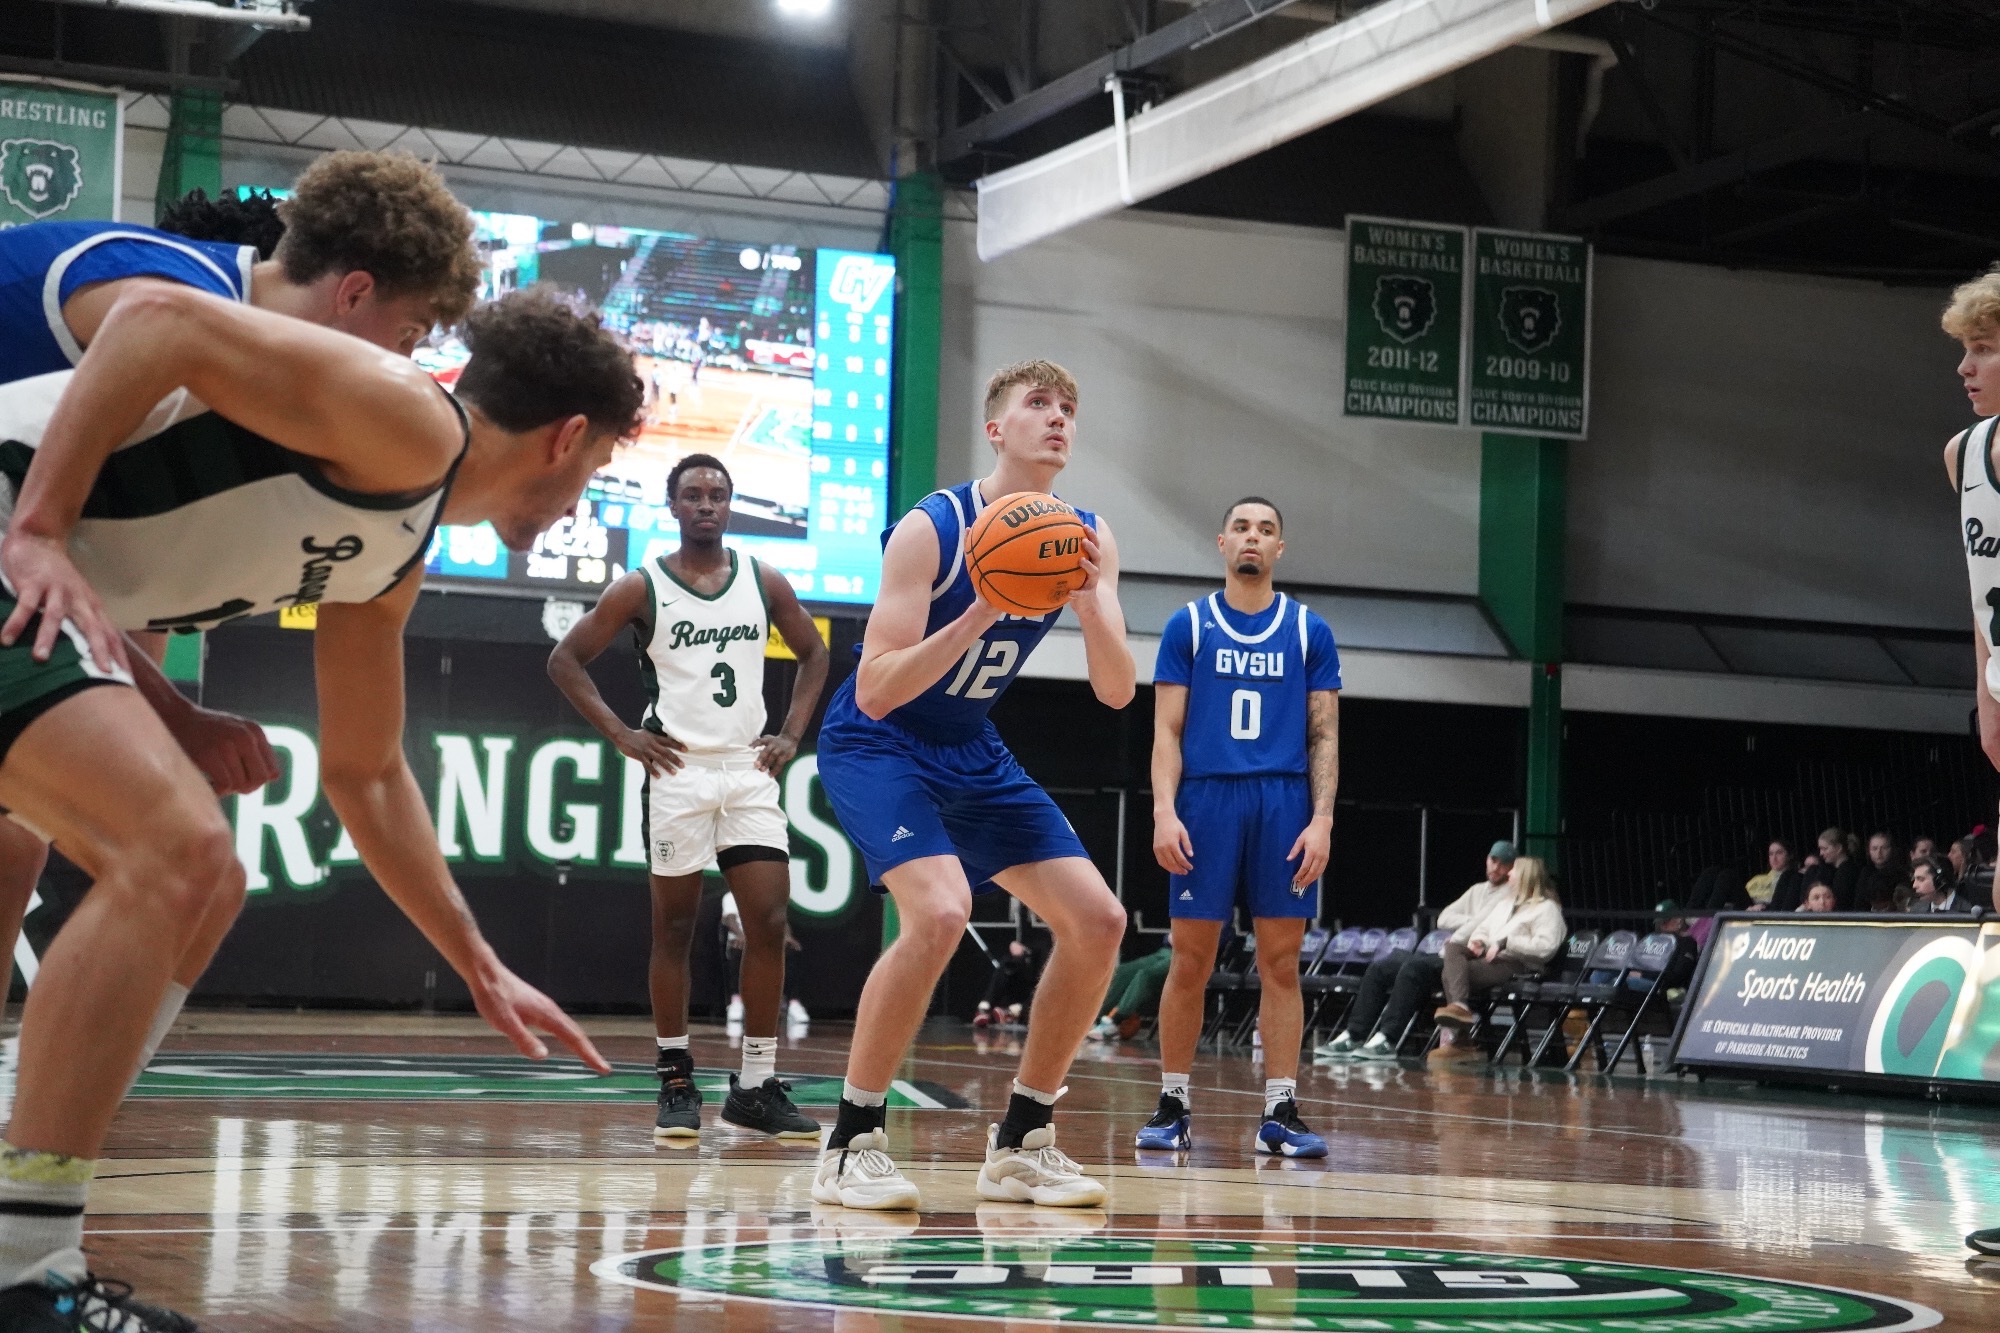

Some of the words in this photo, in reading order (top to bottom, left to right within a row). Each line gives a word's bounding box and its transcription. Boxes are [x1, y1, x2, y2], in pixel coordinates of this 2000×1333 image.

[1368, 226, 1446, 251] WOMEN'S
[1494, 238, 1570, 262] WOMEN'S
[1354, 244, 1459, 273] BASKETBALL
[1480, 256, 1582, 283] BASKETBALL
[1368, 346, 1439, 373] 2011-12
[1486, 356, 1570, 383] 2009-10
[1407, 383, 1453, 398] DIVISION
[1347, 392, 1457, 420] CHAMPIONS
[1473, 401, 1581, 429] CHAMPIONS
[1038, 537, 1079, 560] EVO
[668, 620, 760, 653] Rangers
[945, 638, 1020, 700] 12
[1215, 648, 1284, 677] GVSU
[710, 662, 737, 708] 3
[1230, 689, 1262, 740] 0
[236, 723, 853, 914] RNGS
[1748, 930, 1816, 961] Aurora
[1737, 969, 1799, 1006] Sports
[1799, 972, 1866, 1004] Health
[1713, 1020, 1750, 1035] OFFICIAL
[1749, 1022, 1802, 1039] HEALTHCARE
[1800, 1025, 1843, 1041] PROVIDER
[1726, 1041, 1767, 1057] PARKSIDE
[1763, 1043, 1809, 1060] ATHLETICS
[862, 1266, 1580, 1289] GLIAC
